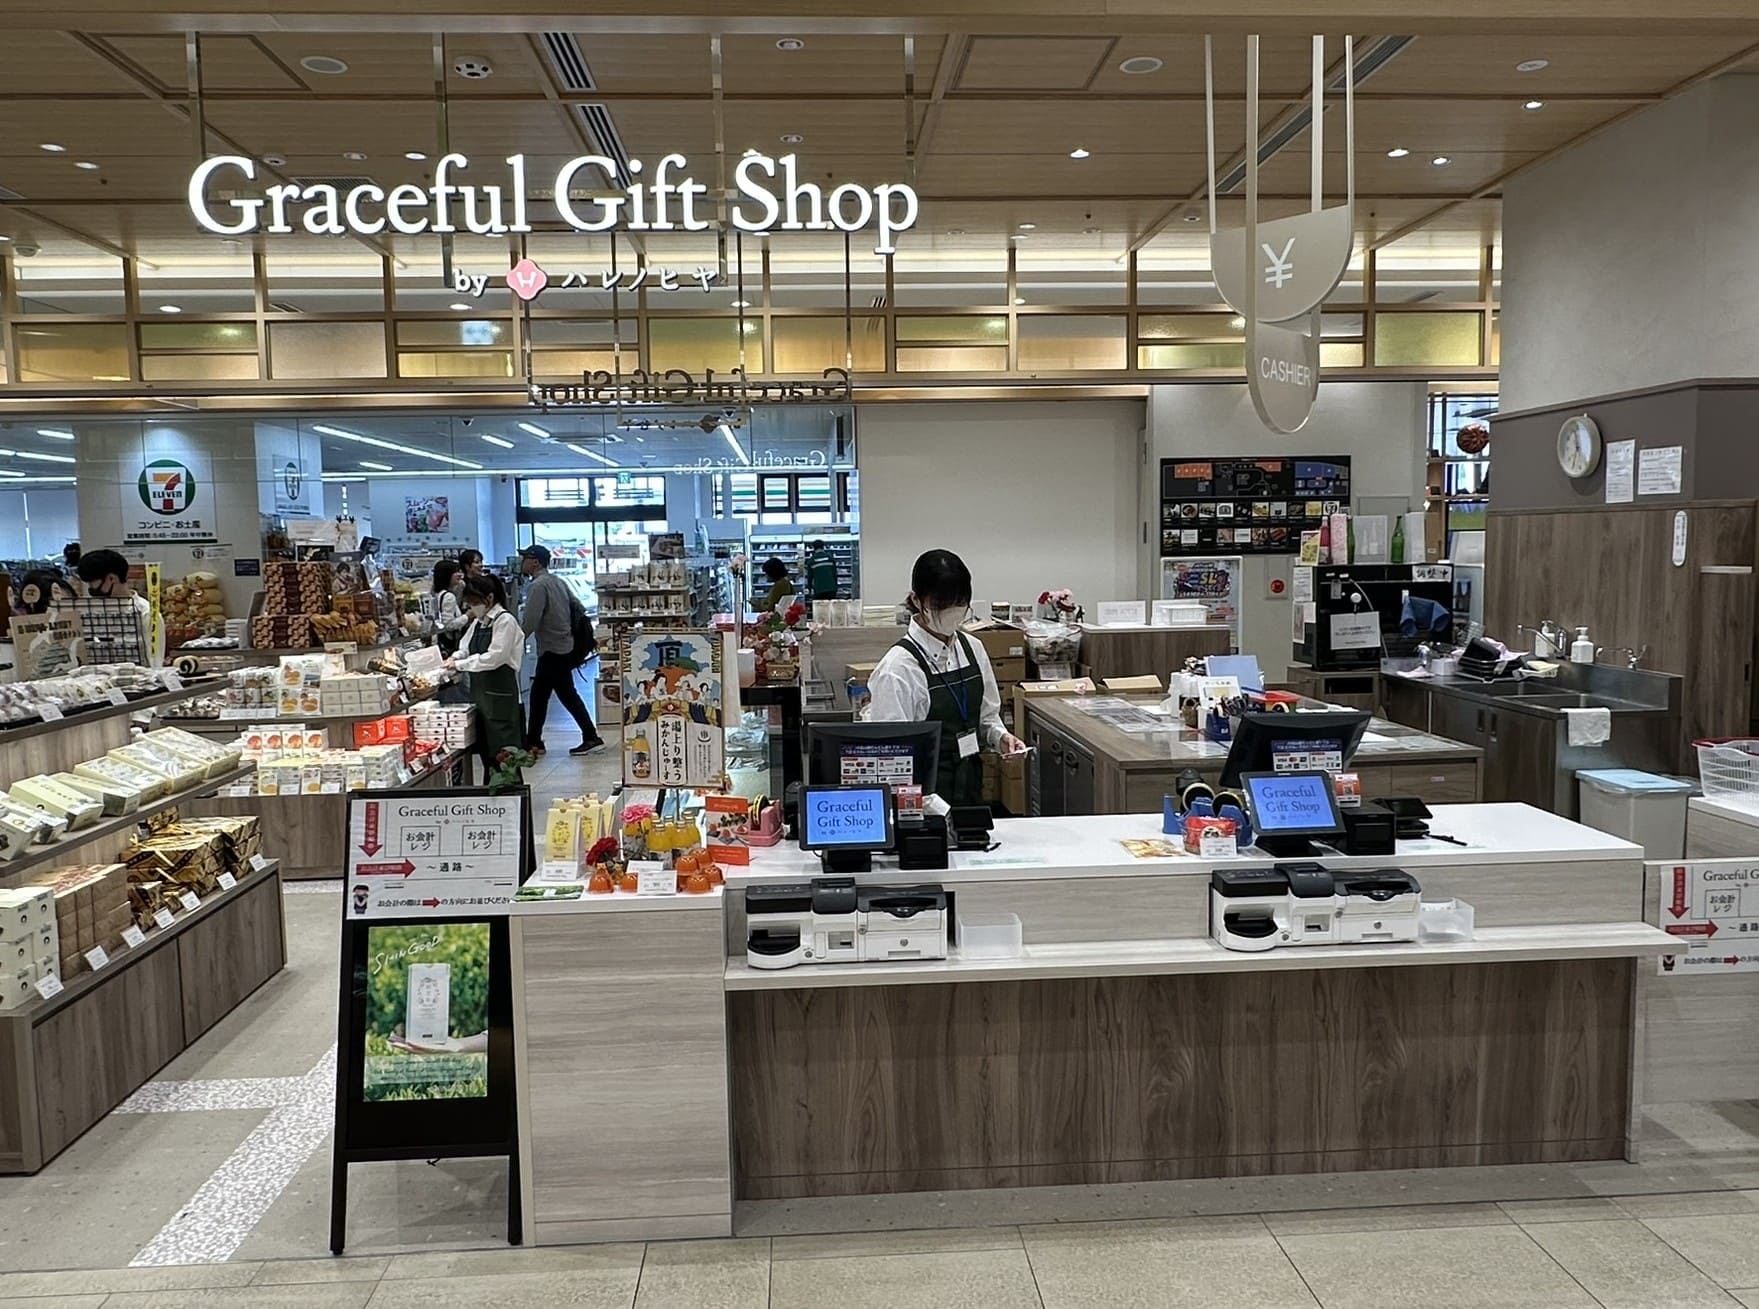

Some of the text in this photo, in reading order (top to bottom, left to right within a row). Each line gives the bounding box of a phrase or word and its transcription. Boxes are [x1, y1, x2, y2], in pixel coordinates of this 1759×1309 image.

[187, 152, 919, 255] Graceful Gift Shop
[453, 269, 488, 297] by
[561, 268, 718, 293] ハレノヒヤ
[1261, 356, 1312, 387] CASHIER
[660, 720, 671, 780] みかんじゅーす
[1262, 785, 1317, 799] Graceful
[398, 804, 506, 818] Graceful Gift Shop
[817, 800, 872, 812] Graceful
[1266, 800, 1320, 815] Gift Shop
[818, 815, 874, 829] Gift Shop
[406, 832, 434, 841] お会計
[467, 830, 496, 840] お会計
[1704, 869, 1748, 881] Graceful
